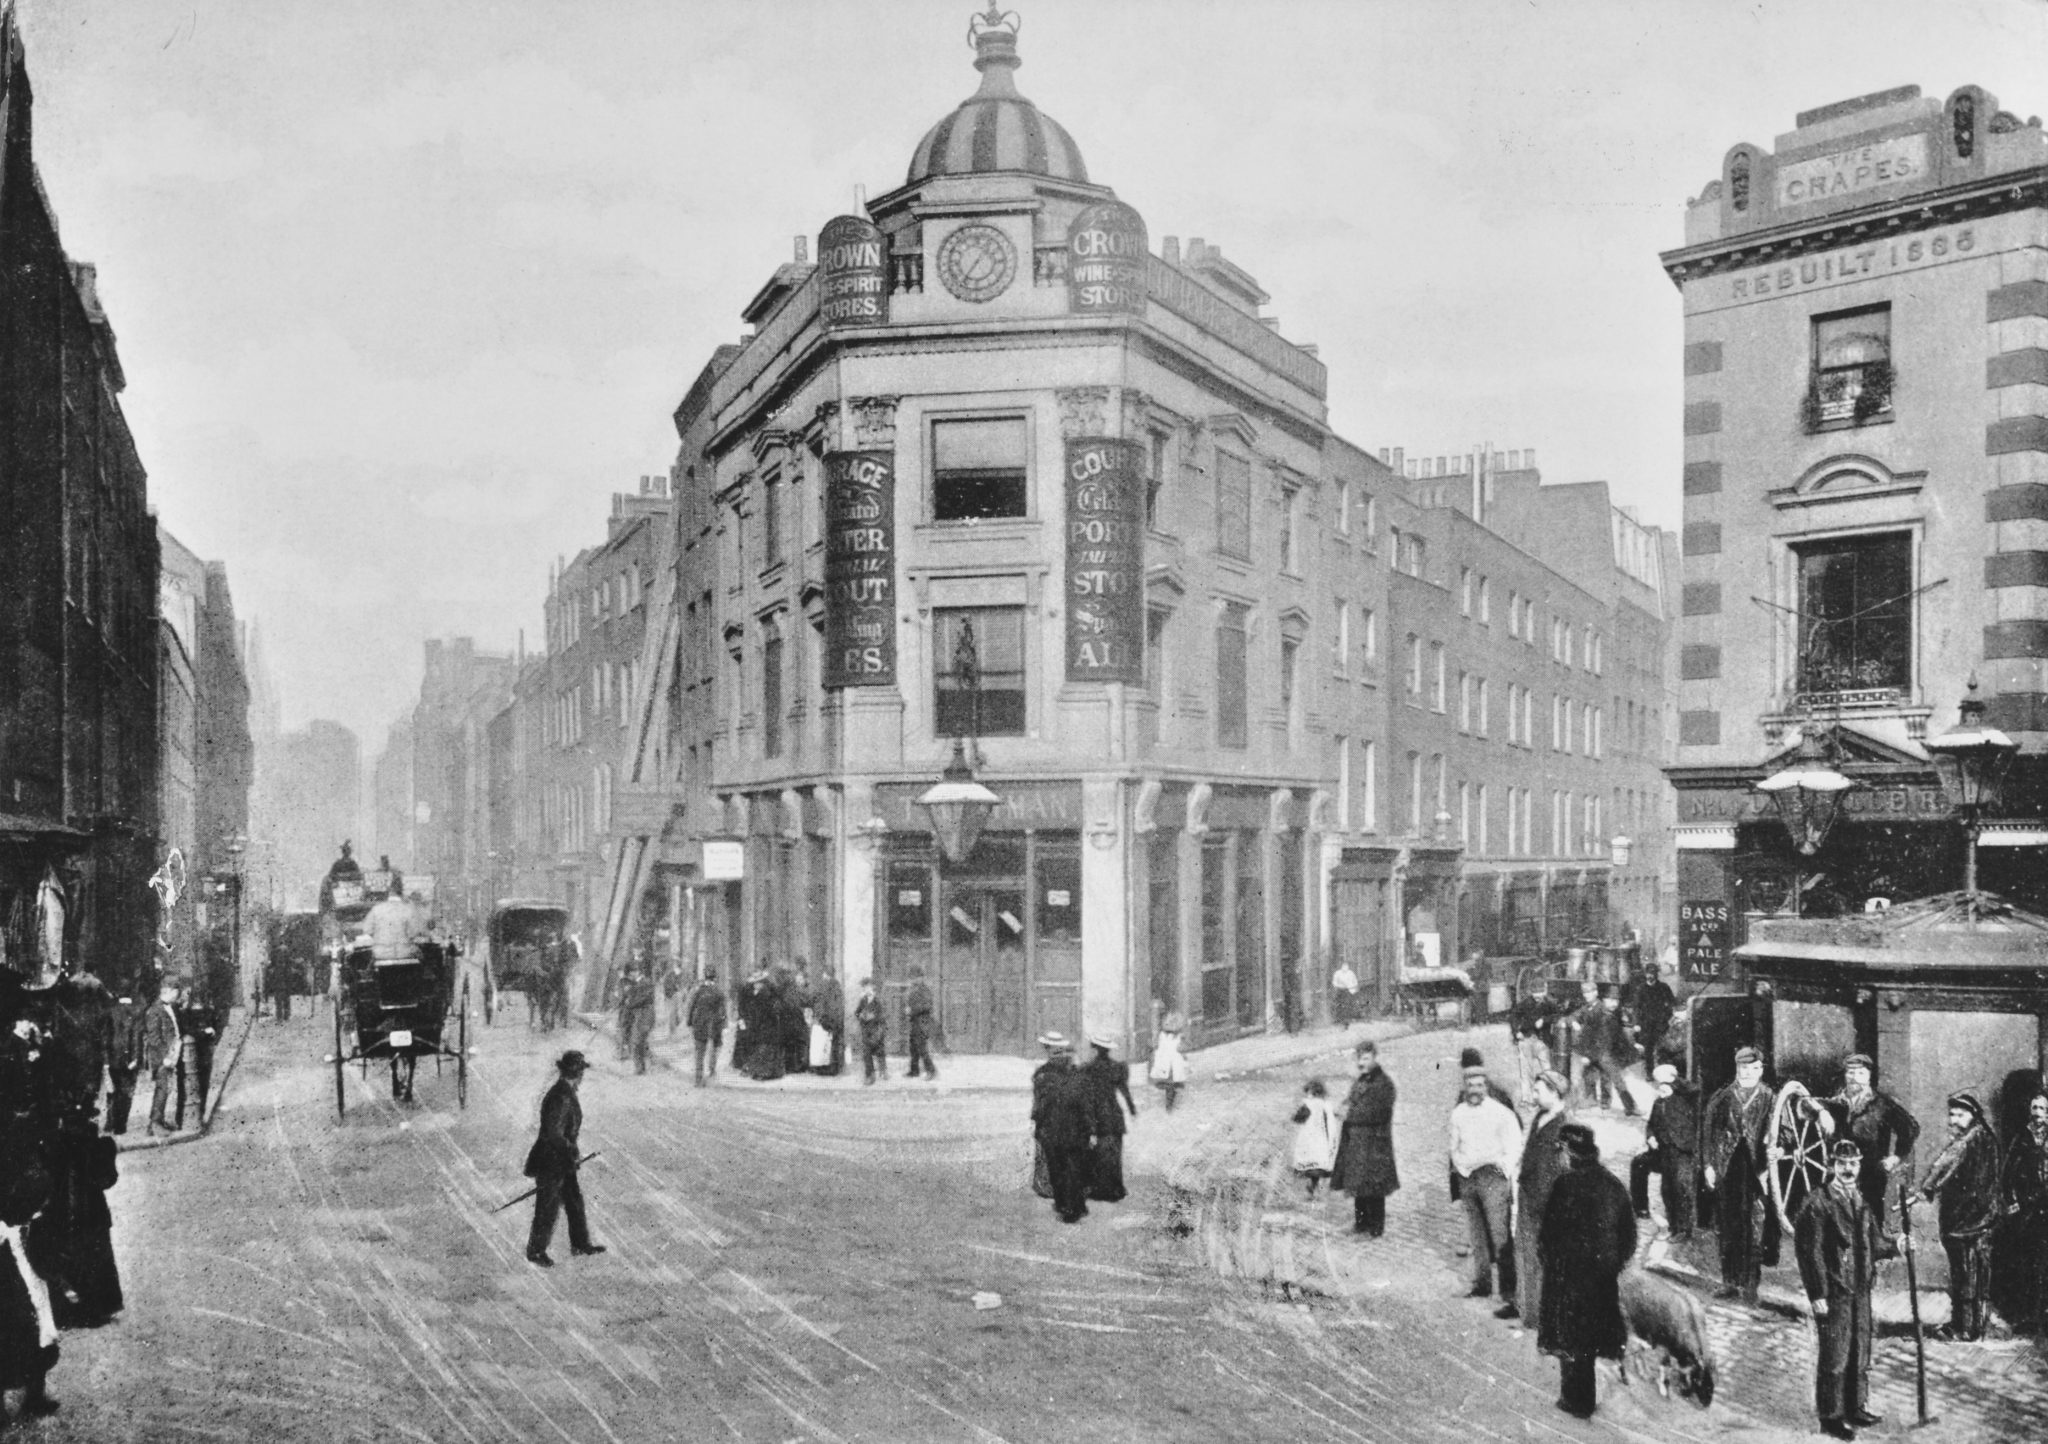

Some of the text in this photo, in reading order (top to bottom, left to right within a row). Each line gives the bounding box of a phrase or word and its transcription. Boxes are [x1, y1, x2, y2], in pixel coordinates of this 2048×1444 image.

[1732, 250, 1876, 299] REBUILT
[1682, 906, 1728, 922] BASS
[1687, 948, 1722, 959] PALE
[1689, 963, 1720, 976] ALE
